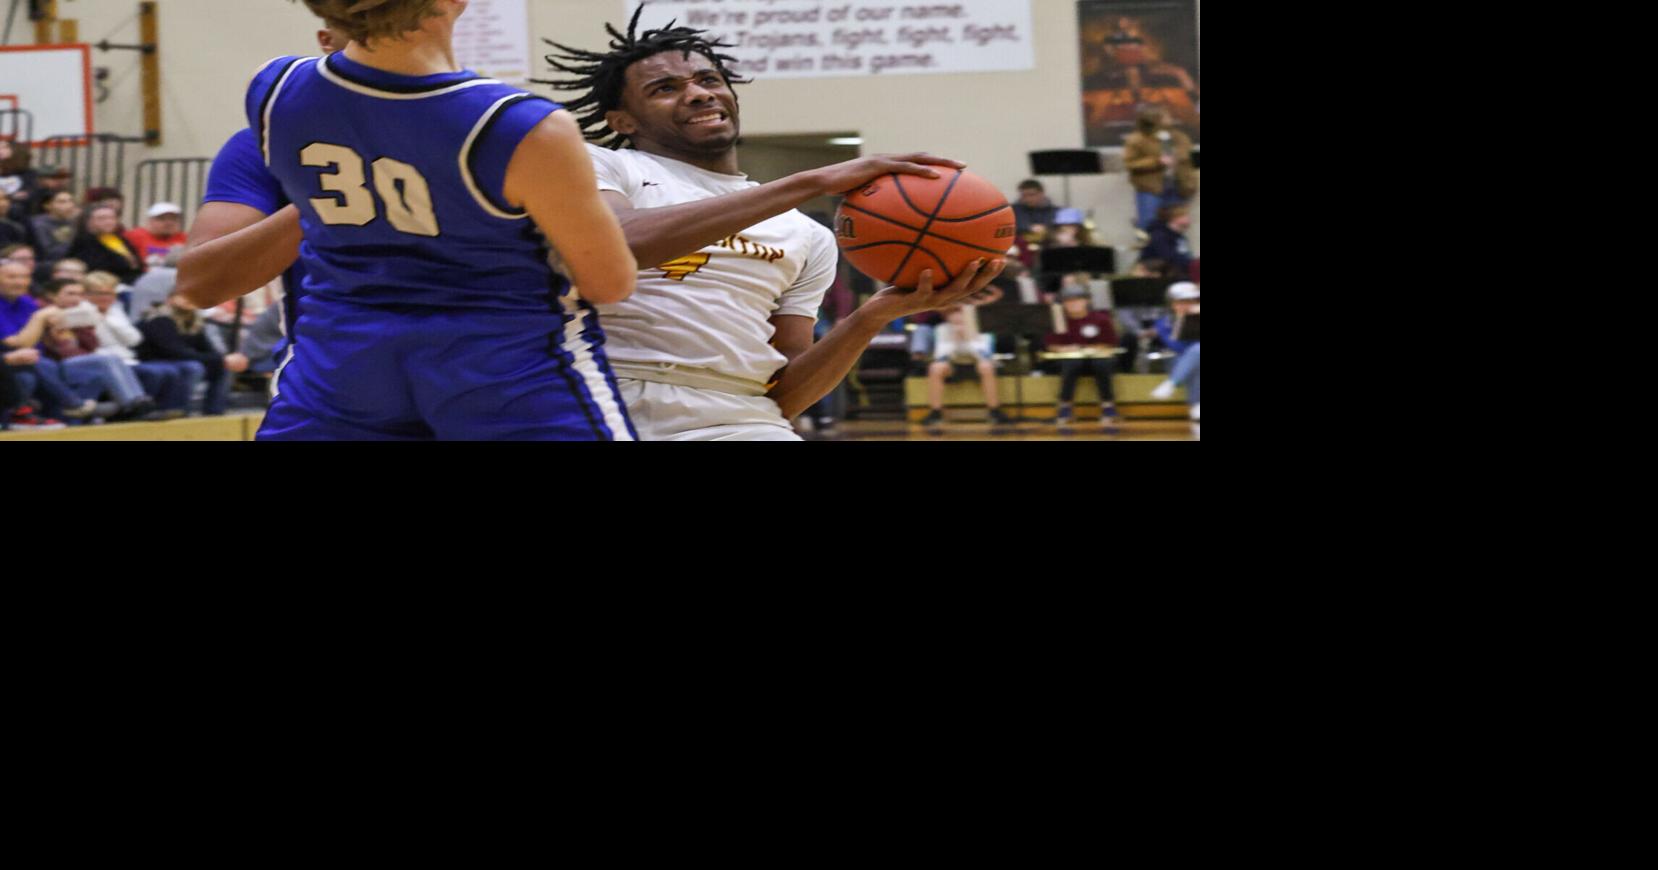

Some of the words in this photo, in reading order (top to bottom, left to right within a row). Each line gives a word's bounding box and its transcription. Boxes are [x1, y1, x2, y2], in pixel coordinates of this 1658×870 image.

[754, 7, 820, 28] proud
[827, 5, 850, 22] of
[855, 7, 894, 22] our
[776, 57, 814, 71] win
[820, 53, 863, 70] this
[299, 140, 441, 237] 30
